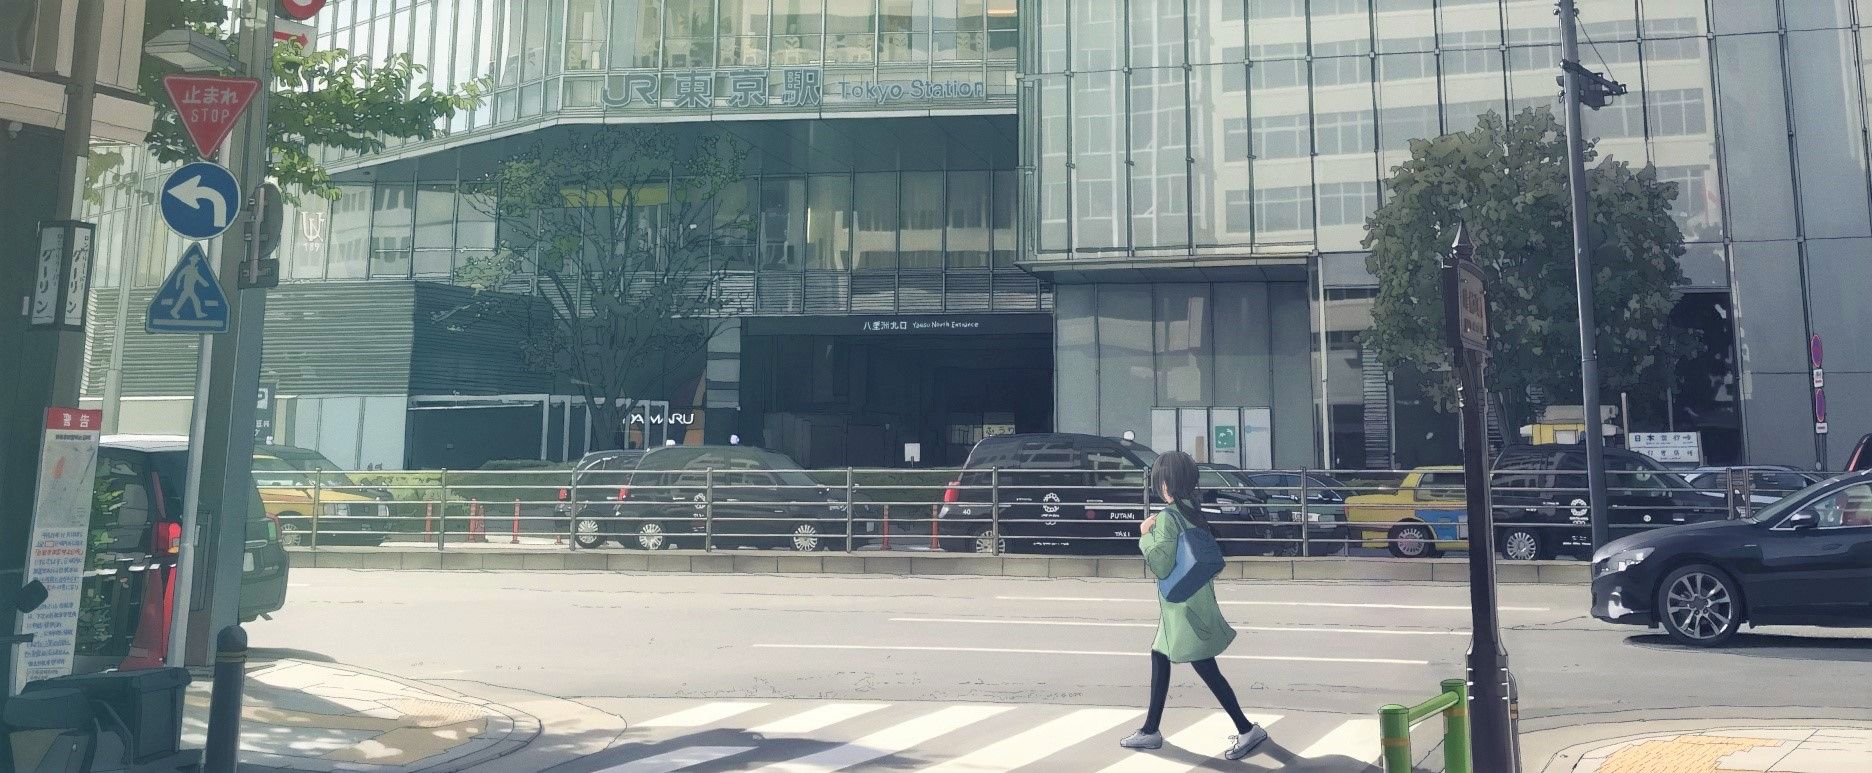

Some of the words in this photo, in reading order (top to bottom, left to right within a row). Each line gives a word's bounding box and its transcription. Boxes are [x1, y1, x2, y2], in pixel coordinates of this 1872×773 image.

[182, 85, 239, 105] 止まれ
[838, 80, 904, 104] Tokyo
[910, 79, 985, 99] Station
[191, 108, 230, 124] STOP
